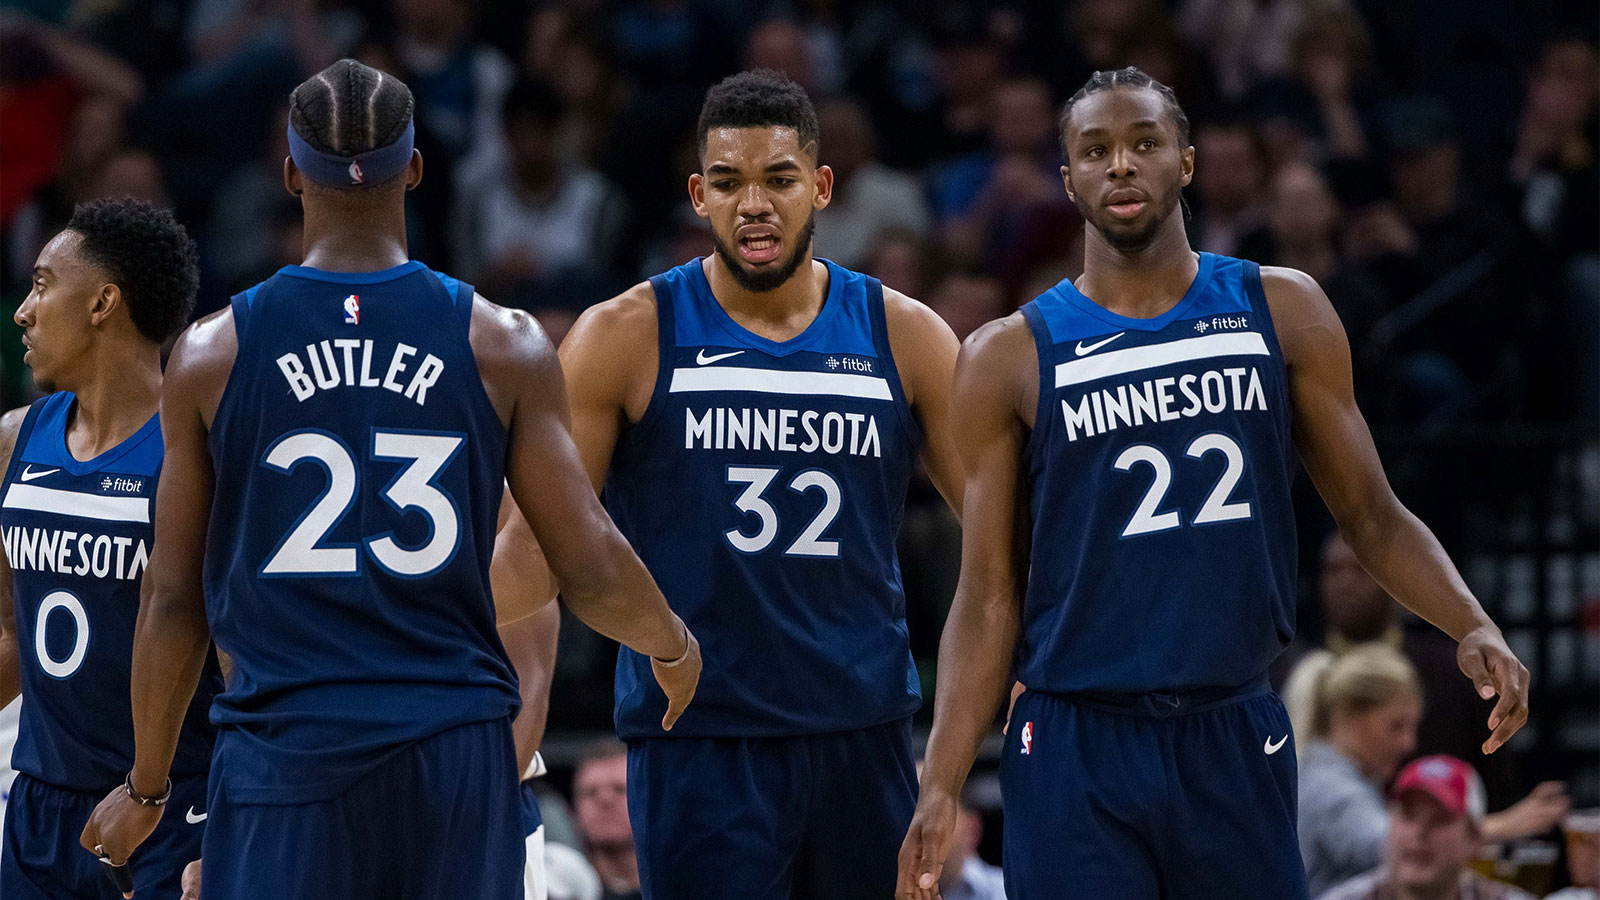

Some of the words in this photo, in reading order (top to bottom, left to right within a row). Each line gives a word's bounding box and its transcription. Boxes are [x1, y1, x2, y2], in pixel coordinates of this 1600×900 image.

[1212, 316, 1248, 330] fitbit
[277, 339, 444, 405] BUTLER
[842, 357, 873, 373] fitbit
[685, 407, 881, 457] MINNESOTA
[1062, 367, 1267, 442] MINNESOTA
[113, 477, 142, 493] fitbit
[262, 432, 463, 576] 23
[724, 467, 841, 557] 32
[1114, 433, 1252, 537] 22
[35, 591, 90, 678] 0
